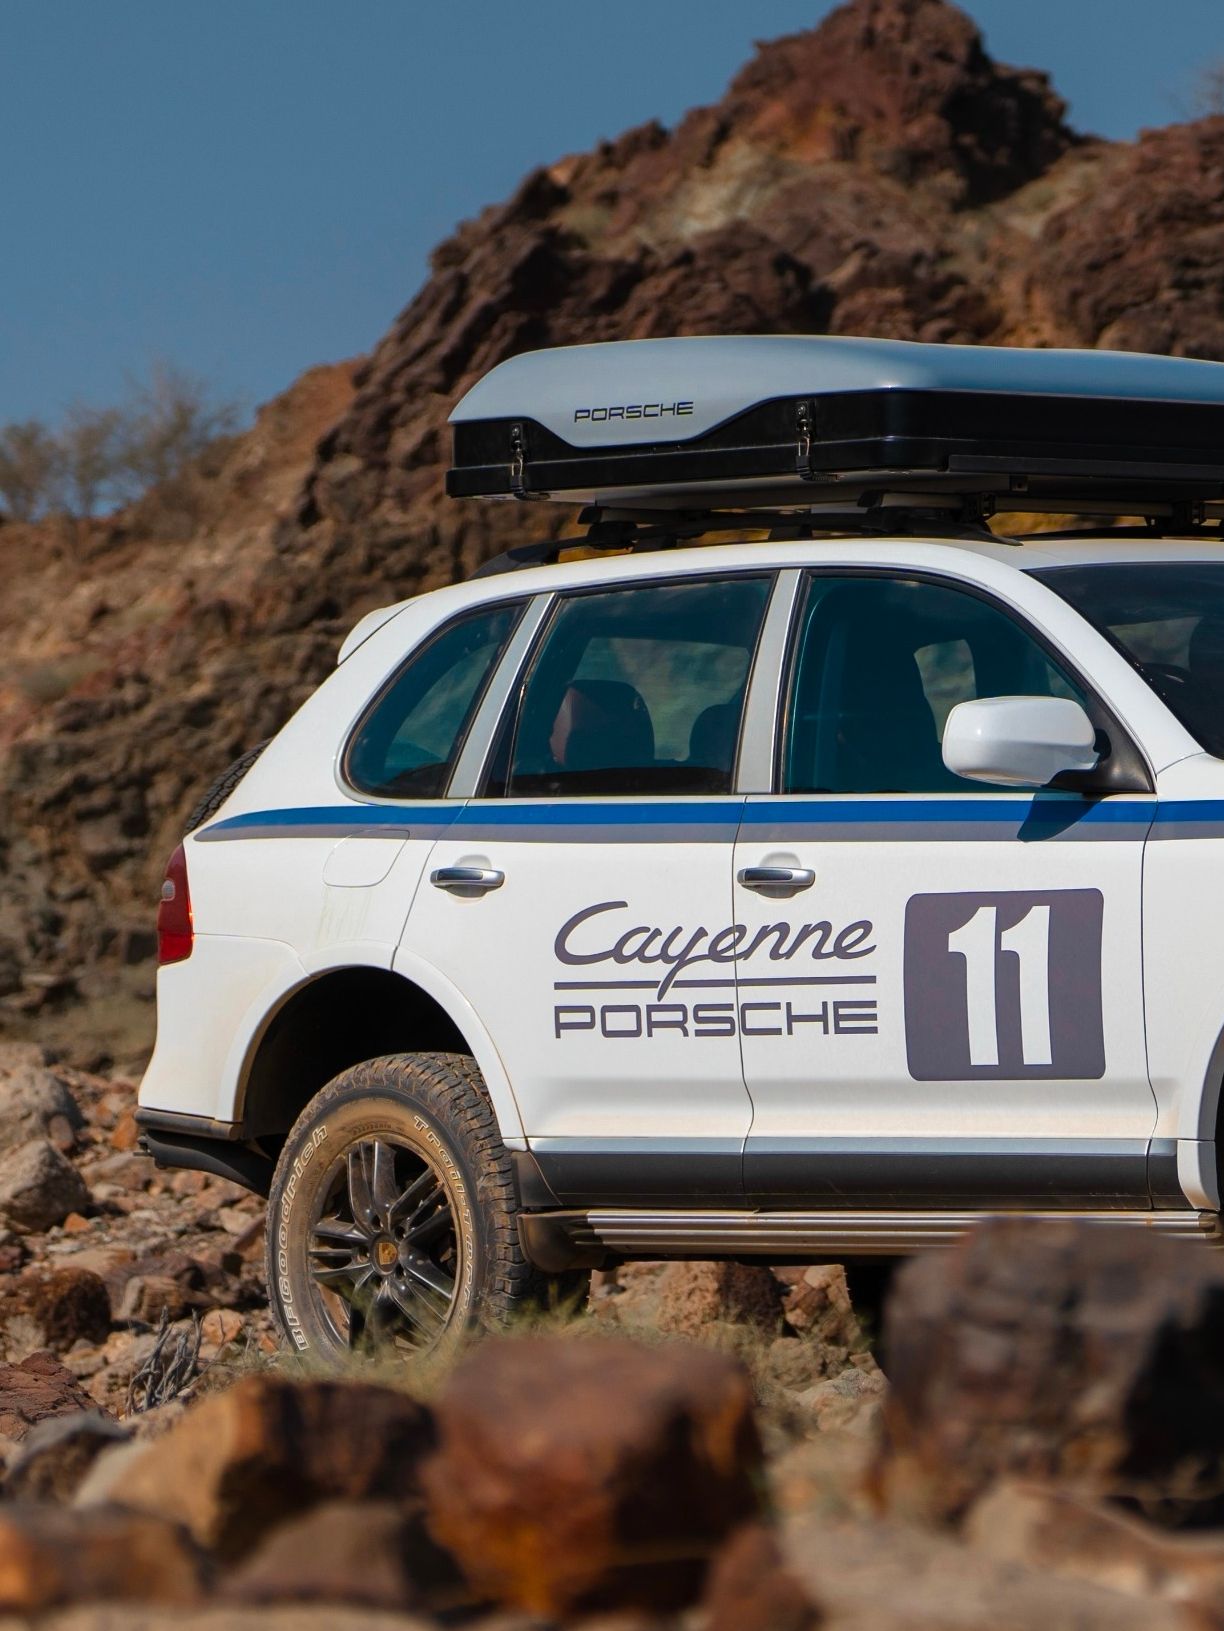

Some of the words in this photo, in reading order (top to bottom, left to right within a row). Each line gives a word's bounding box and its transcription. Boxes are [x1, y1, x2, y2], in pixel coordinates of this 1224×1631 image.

[574, 401, 695, 423] PORSCHE
[554, 901, 877, 1002] Cayenne
[947, 905, 1053, 1066] 11
[554, 1000, 879, 1039] PORSCHE
